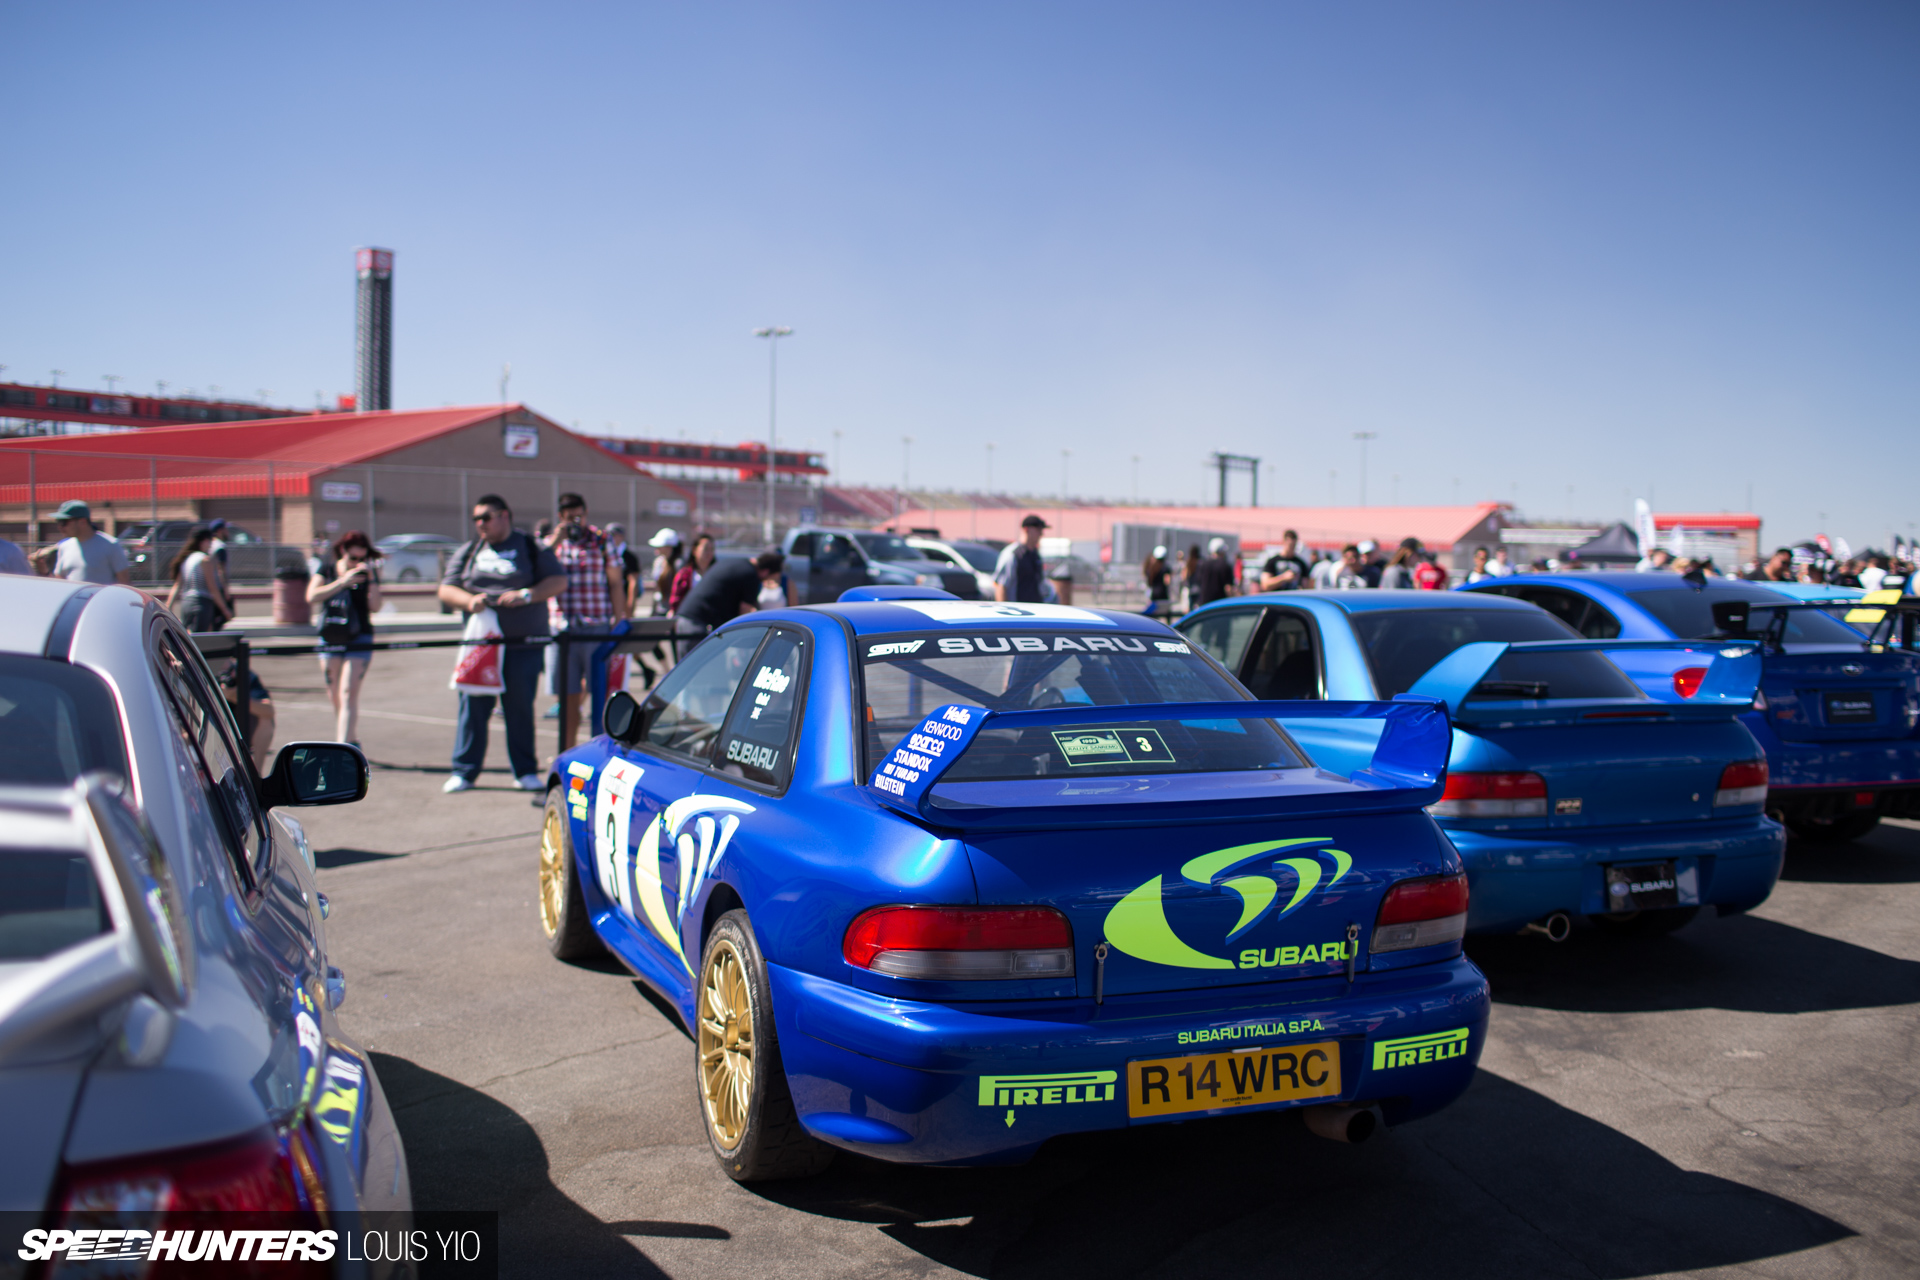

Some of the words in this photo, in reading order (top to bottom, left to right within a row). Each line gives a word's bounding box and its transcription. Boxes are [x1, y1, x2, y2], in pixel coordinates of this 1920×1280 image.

[937, 637, 1148, 653] SUBARU
[942, 705, 971, 725] Hella
[922, 720, 963, 741] KENWOOD
[726, 739, 779, 770] SUBARU
[1136, 737, 1153, 752] 3
[893, 748, 933, 772] STANDOX
[874, 773, 906, 796] BILSTEIN
[893, 766, 920, 783] TURBO
[1631, 880, 1675, 893] SUBARU
[1239, 940, 1359, 969] SUBARU
[1177, 1026, 1241, 1044] SUBARU
[1244, 1022, 1287, 1038] ITALIA
[1288, 1019, 1325, 1033] S.P.A.
[1372, 1027, 1470, 1070] PIRELLI
[1227, 1048, 1329, 1095] WRC
[978, 1070, 1118, 1106] PIRELLI
